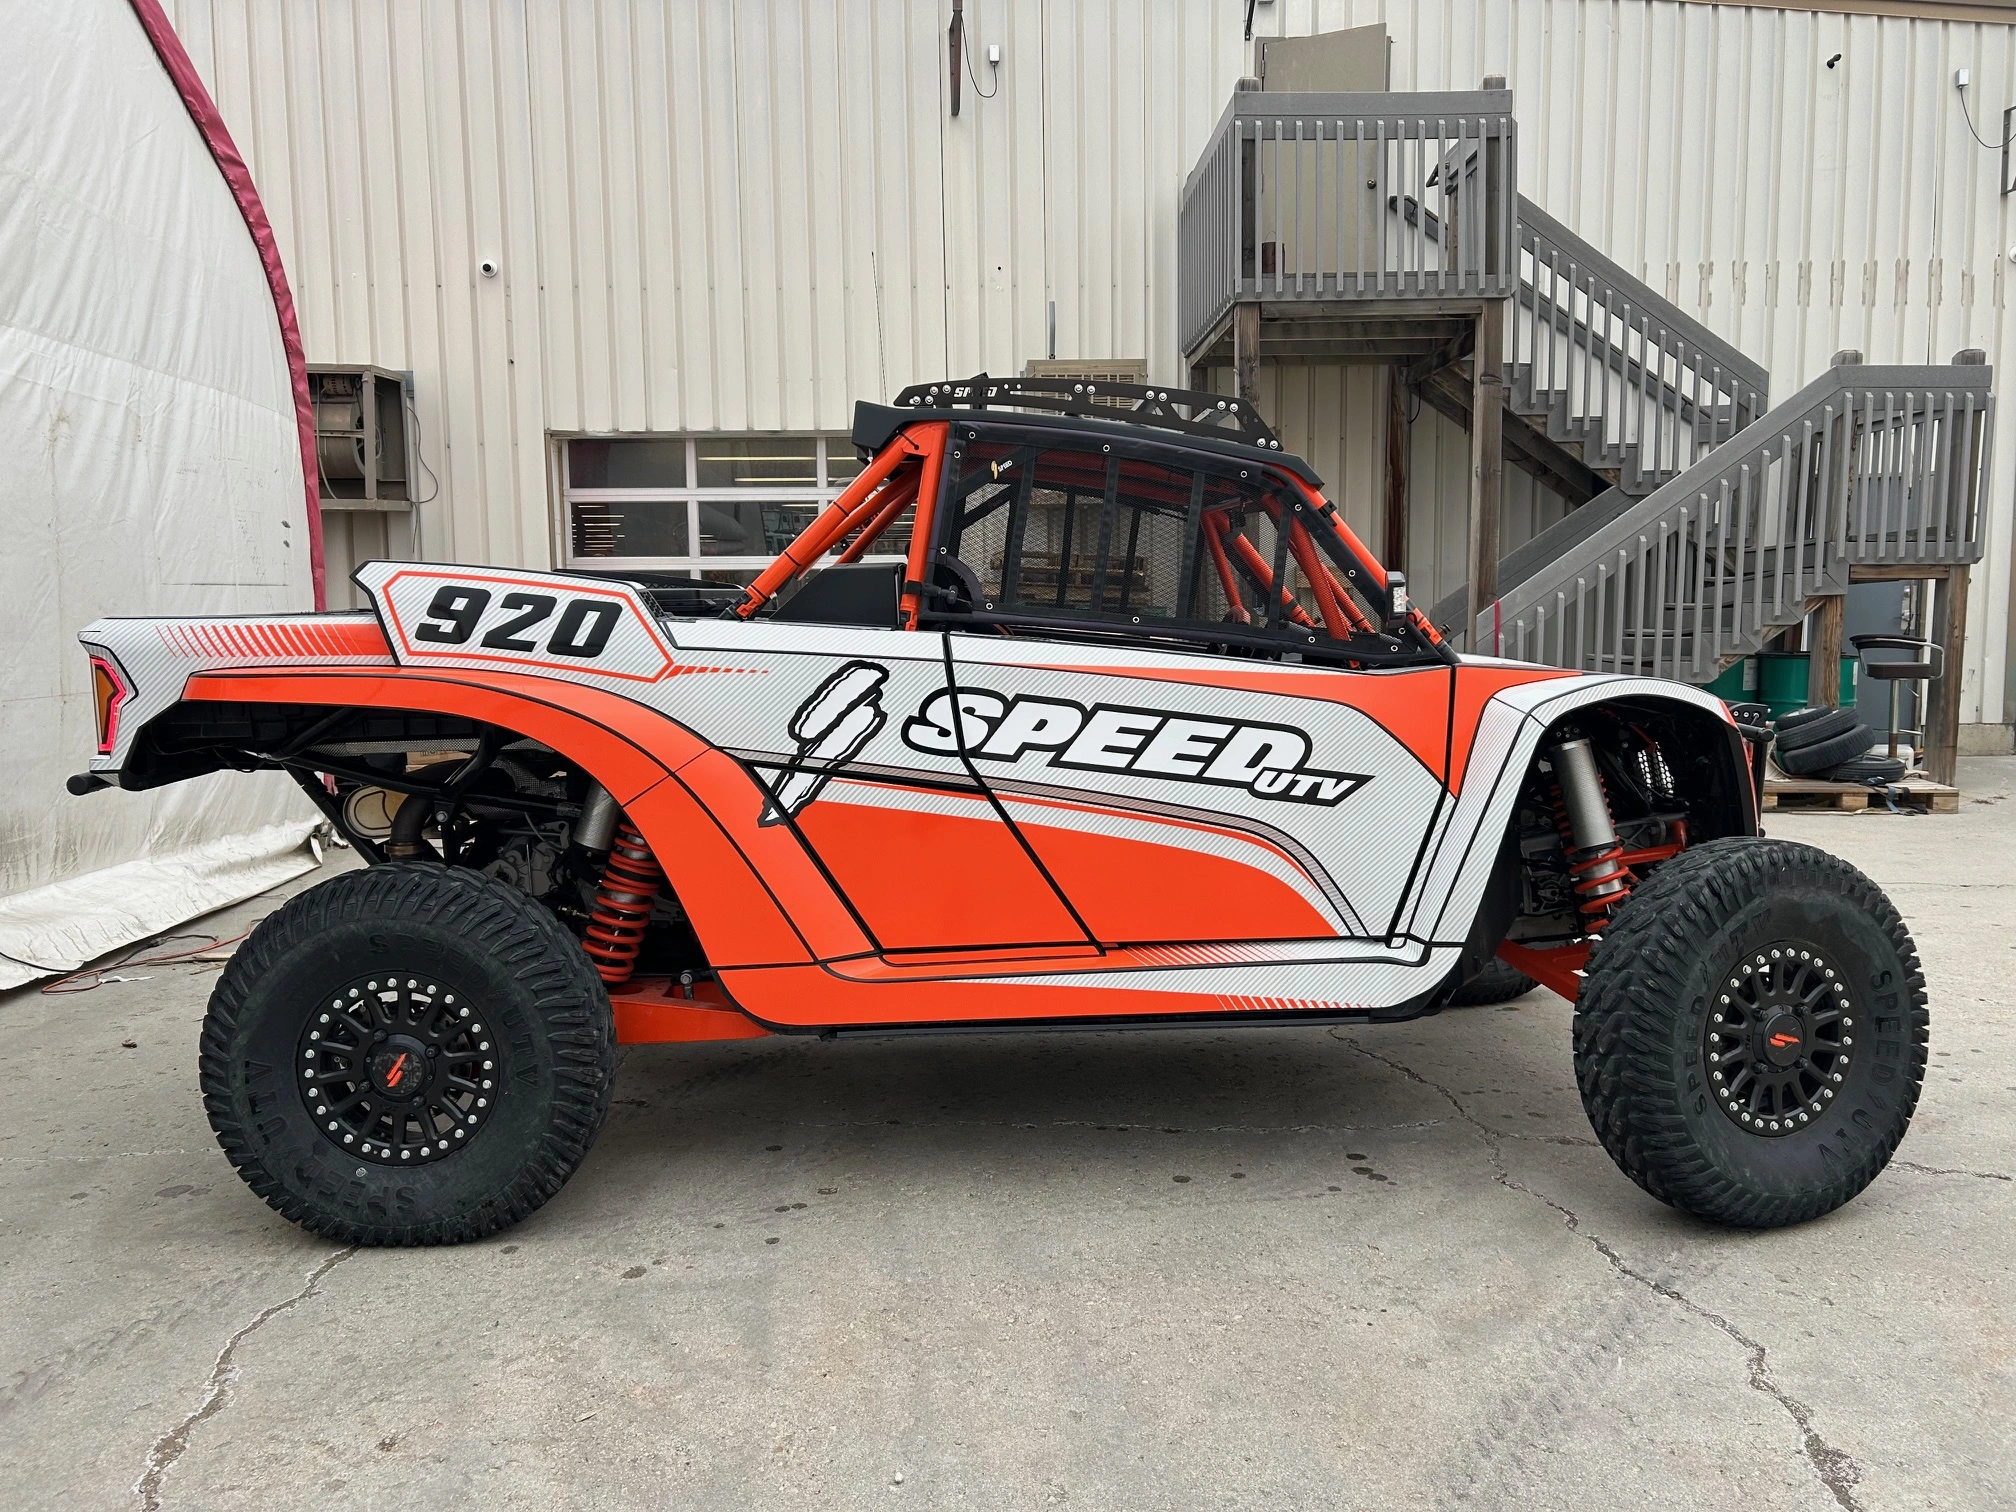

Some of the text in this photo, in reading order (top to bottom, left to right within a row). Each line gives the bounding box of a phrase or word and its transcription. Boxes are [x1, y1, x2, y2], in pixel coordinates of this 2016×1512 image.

[415, 585, 623, 658] 920
[902, 687, 1366, 805] SPEED UTV
[369, 933, 540, 1089] SPEED UTV
[1685, 907, 1772, 1116] SPEED UTV
[1817, 969, 1902, 1170] SPEED UTV
[244, 1060, 416, 1215] SPEED UTV
